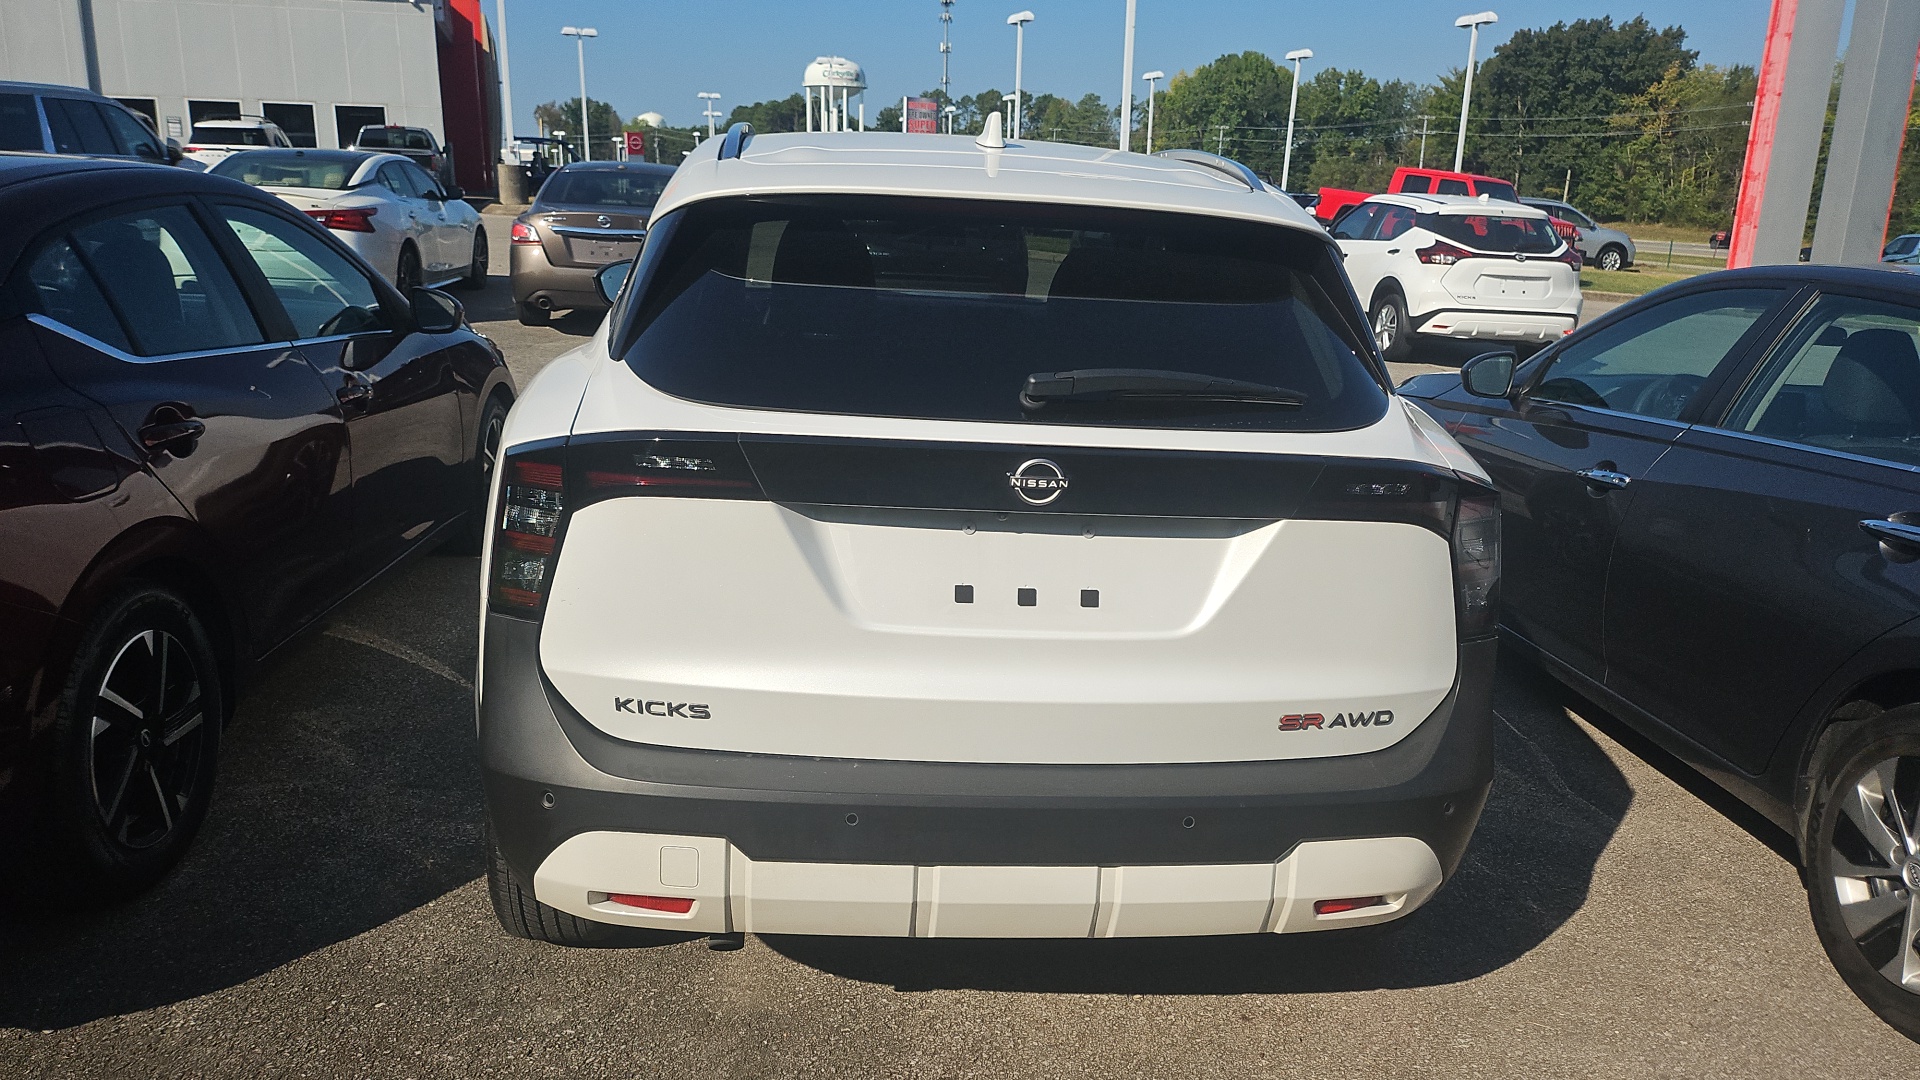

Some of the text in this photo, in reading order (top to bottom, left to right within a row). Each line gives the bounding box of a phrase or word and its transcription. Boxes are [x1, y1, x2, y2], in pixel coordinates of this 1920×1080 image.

[822, 70, 854, 79] Clrksville
[908, 119, 937, 130] SUPER
[1010, 478, 1069, 488] NISSAN
[614, 696, 712, 720] KICKS
[1278, 709, 1395, 732] SR AWD
